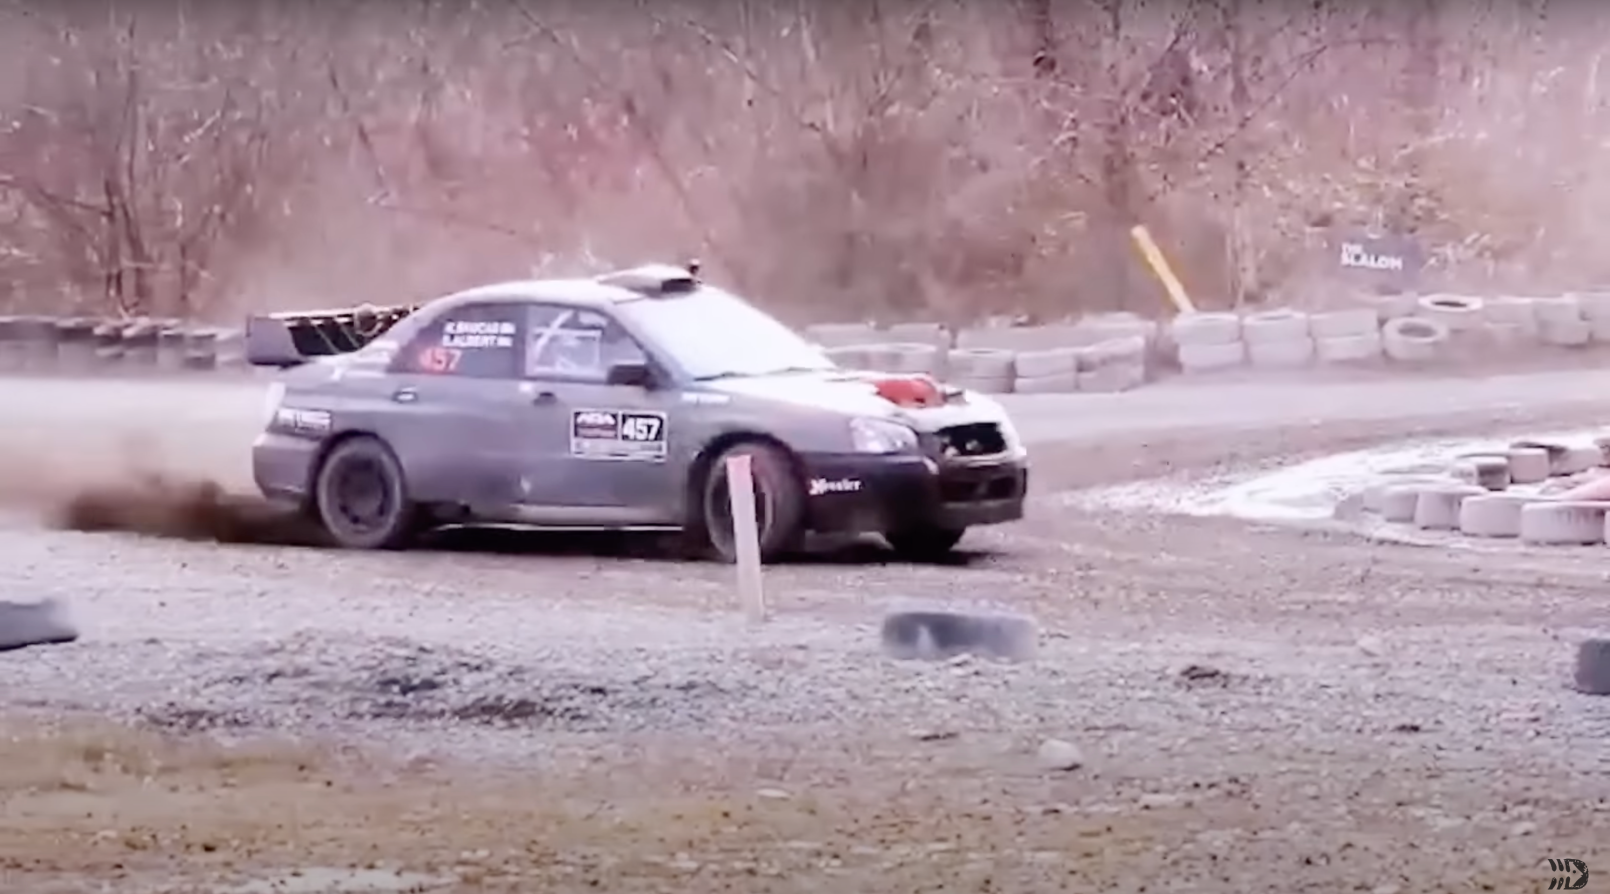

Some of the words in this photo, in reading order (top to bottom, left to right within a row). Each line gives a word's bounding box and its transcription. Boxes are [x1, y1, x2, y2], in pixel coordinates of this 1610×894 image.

[1341, 253, 1403, 270] SLALOM
[419, 348, 462, 372] 457
[622, 417, 661, 441] 457
